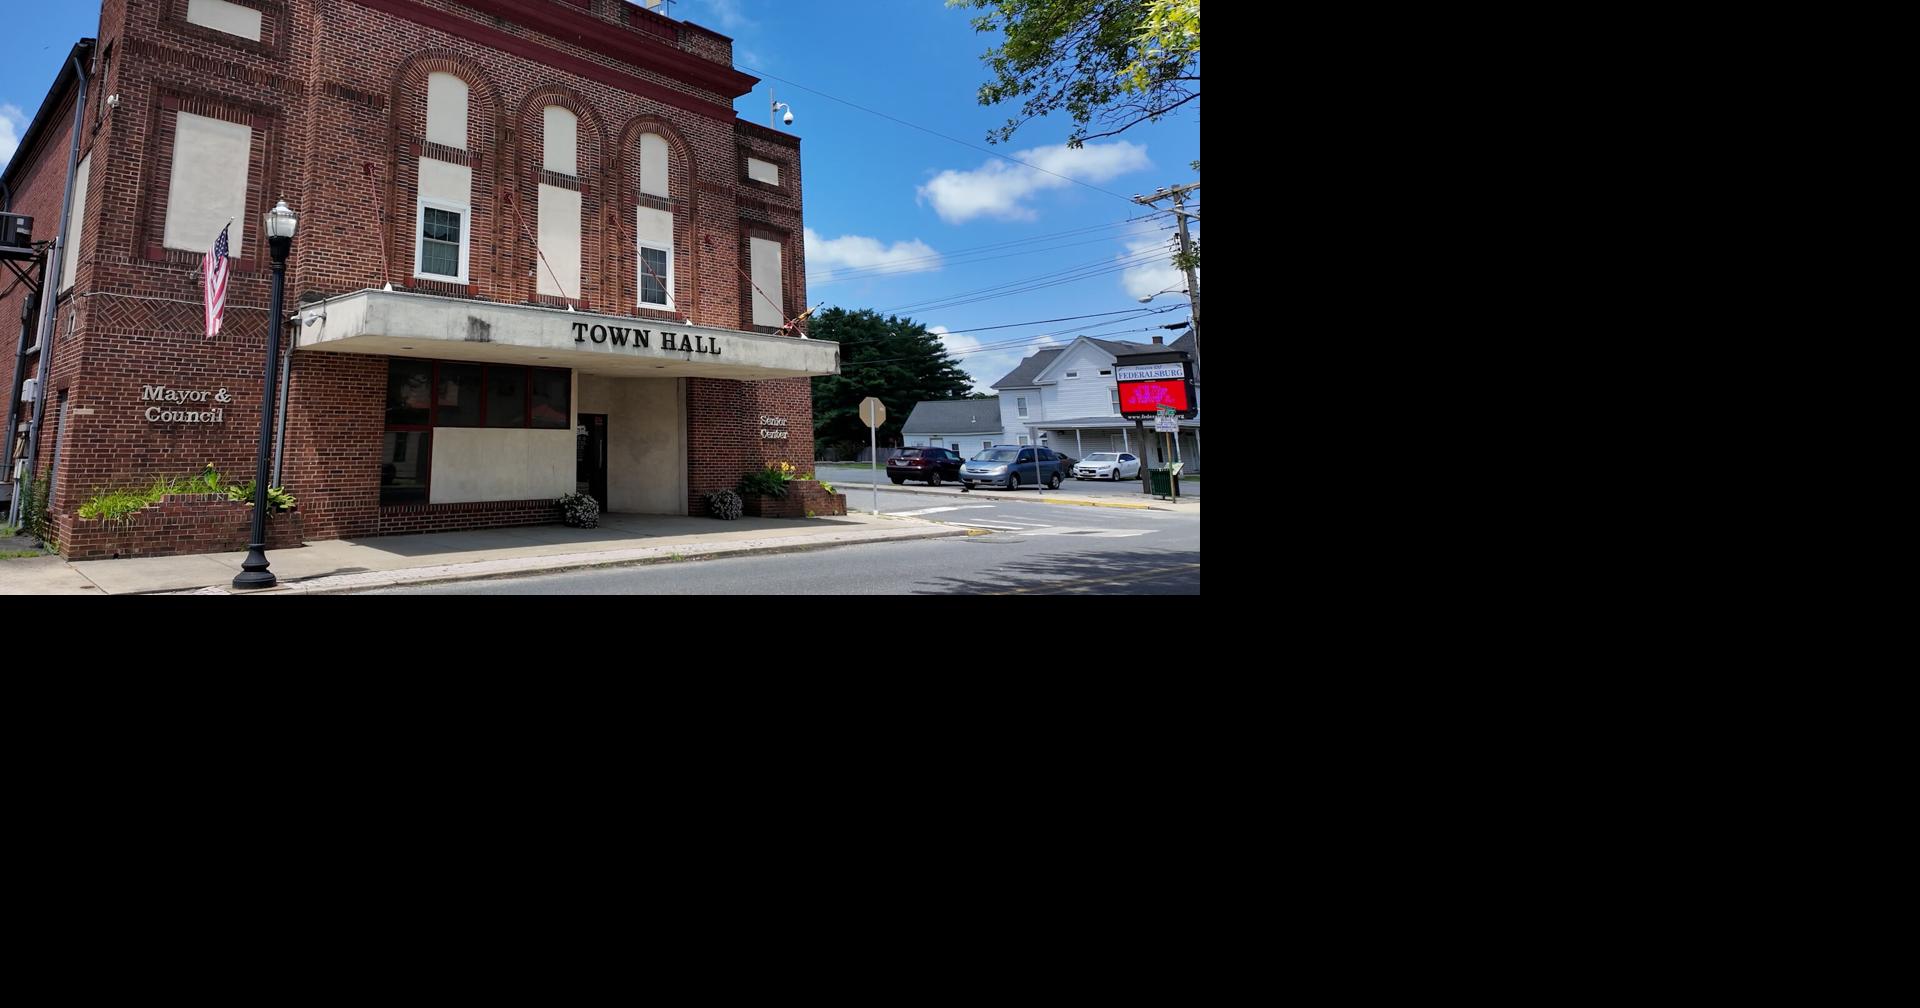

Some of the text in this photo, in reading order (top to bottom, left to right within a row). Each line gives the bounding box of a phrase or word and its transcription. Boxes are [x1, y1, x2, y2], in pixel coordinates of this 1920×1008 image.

[572, 322, 721, 355] TOWN HALL
[1118, 369, 1183, 379] FEDERALSBURG
[142, 384, 232, 405] Mayor &
[145, 406, 223, 423] Council
[760, 415, 787, 426] Senior
[760, 429, 788, 439] Center
